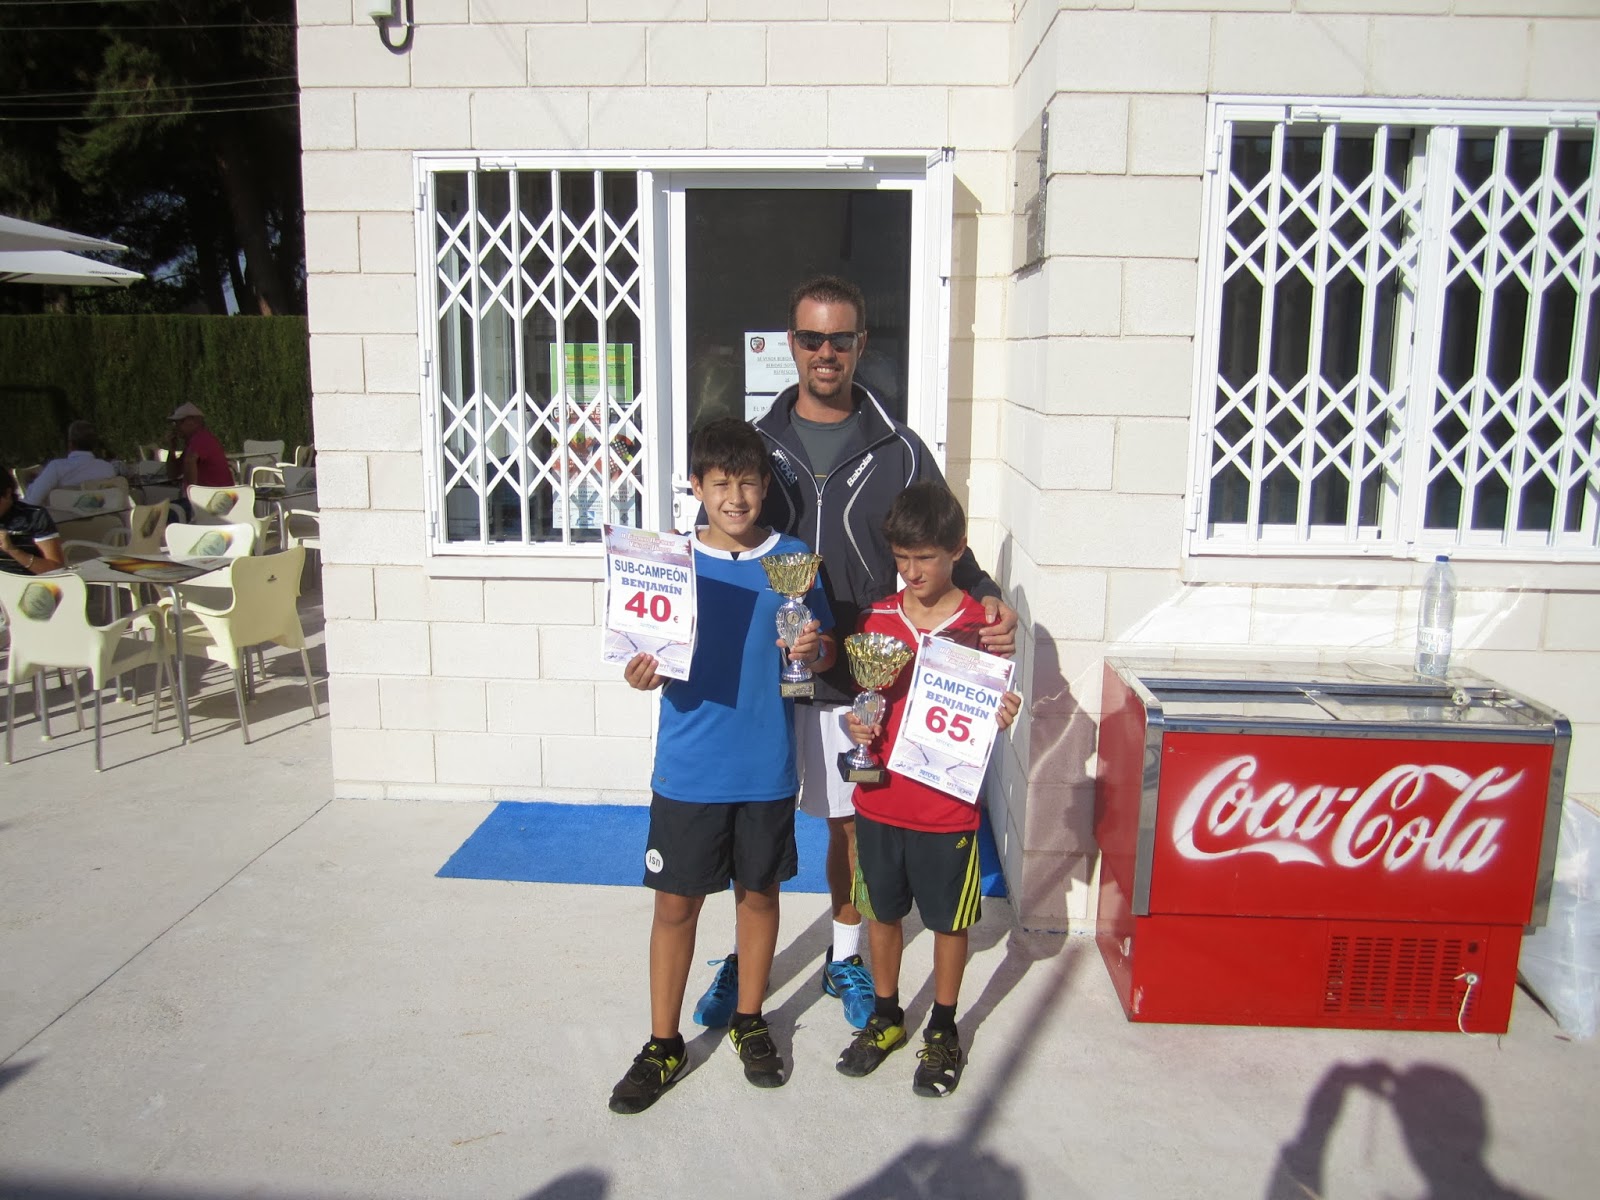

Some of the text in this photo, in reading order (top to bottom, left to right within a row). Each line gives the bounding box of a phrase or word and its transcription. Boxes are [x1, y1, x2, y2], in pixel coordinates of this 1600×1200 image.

[846, 452, 874, 488] Babolat
[614, 559, 688, 584] SUB-CAMPEÓN
[621, 576, 682, 596] BENJAMÍN
[624, 590, 672, 623] 40
[923, 672, 998, 708] CAMPEÓN
[925, 690, 990, 720] BENJAMÍN
[925, 705, 973, 743] 65
[1172, 755, 1525, 873] Coca-Cola
[648, 853, 661, 868] isn
